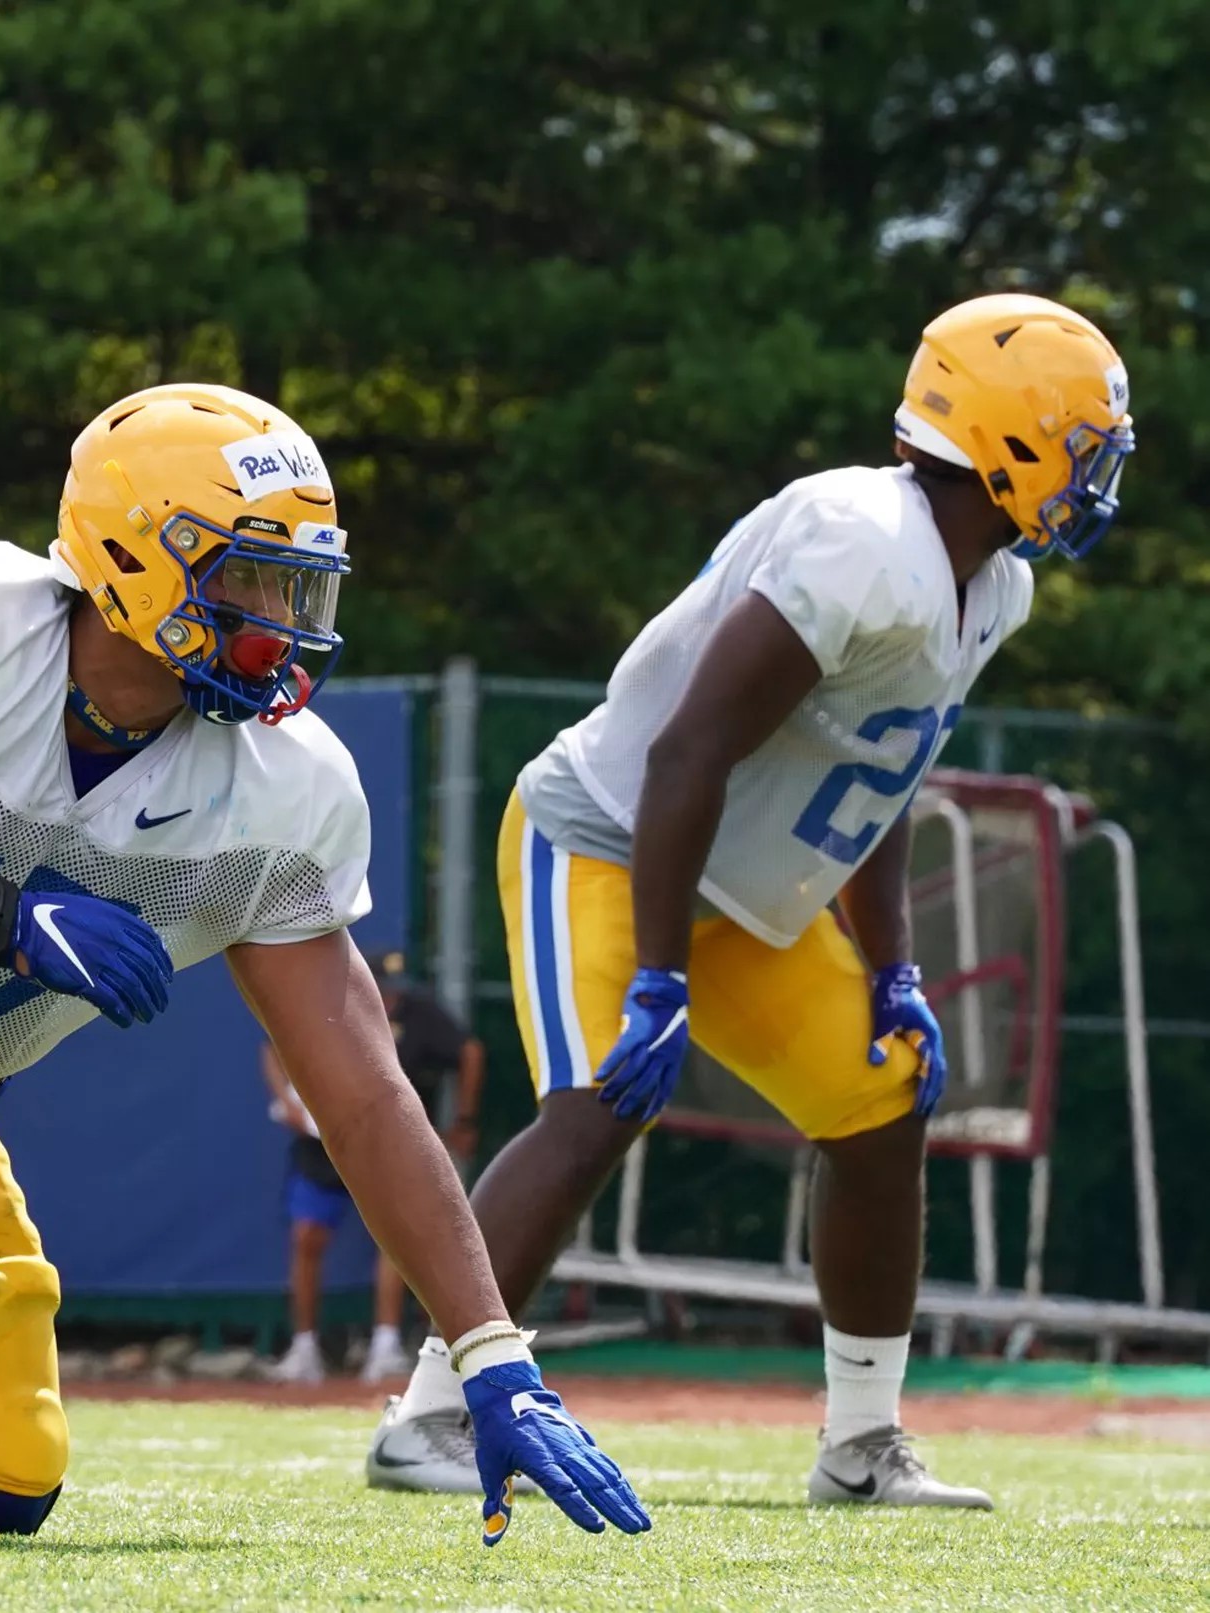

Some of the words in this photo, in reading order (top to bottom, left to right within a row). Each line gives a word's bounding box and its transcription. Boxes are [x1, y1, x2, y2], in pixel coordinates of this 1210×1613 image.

[238, 455, 280, 480] Pitt
[248, 519, 278, 532] schutt
[790, 704, 963, 866] 2
